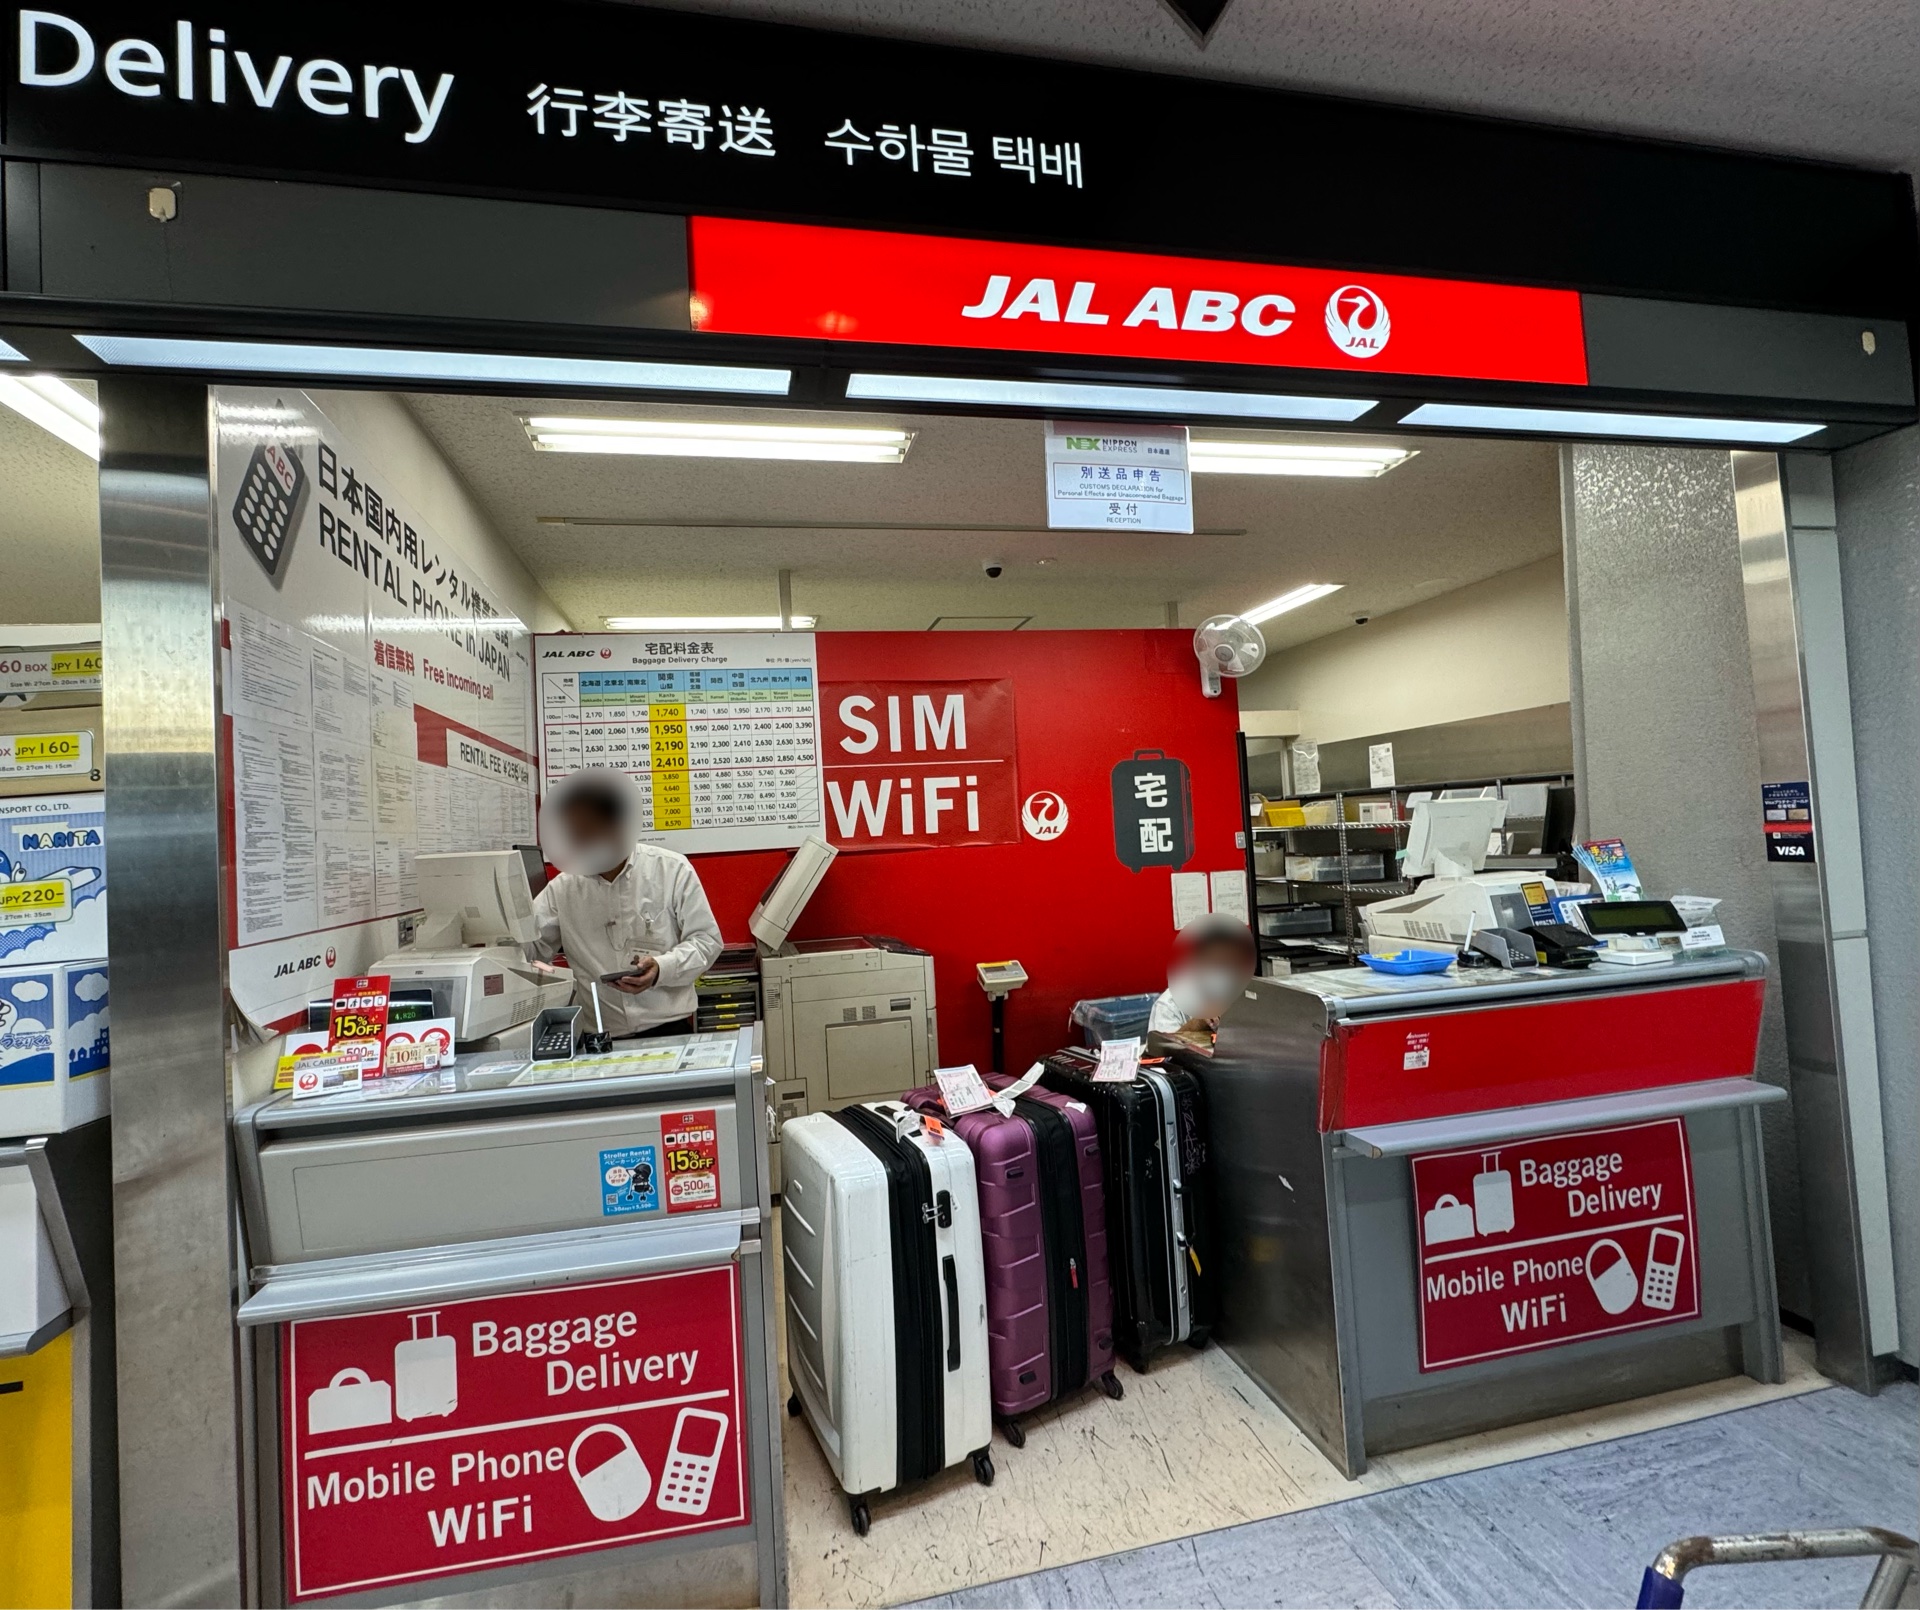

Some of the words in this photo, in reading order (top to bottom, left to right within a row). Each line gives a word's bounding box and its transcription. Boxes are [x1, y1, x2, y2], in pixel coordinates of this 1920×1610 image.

[19, 9, 454, 144] Delivery
[526, 83, 777, 158] 行李寄送
[823, 117, 974, 178] 수하물
[992, 134, 1083, 189] 택배
[961, 274, 1109, 326] JAL
[1122, 287, 1296, 337] ABC
[1345, 336, 1380, 350] JAL
[1102, 438, 1138, 447] NIPPON
[1102, 445, 1138, 454] EXPRESS
[266, 444, 295, 491] ABC
[1081, 466, 1162, 482] 別送品申告
[1079, 483, 1111, 491] CUSTOMS
[1162, 494, 1184, 502] Baggage
[1109, 503, 1138, 516] 受付
[319, 502, 408, 608] RENTAL
[412, 579, 463, 649] PHONE
[478, 636, 510, 683] JAPAN
[542, 651, 565, 659] JAL
[566, 650, 596, 658] ABC
[645, 642, 714, 656] 宅配料金表
[373, 639, 415, 676] 着信無料
[632, 657, 666, 665] Baggage
[668, 656, 699, 665] Delivery
[700, 656, 728, 664] Charge
[0, 660, 22, 674] 60
[25, 663, 48, 672] BOX
[52, 662, 71, 671] JPY
[423, 657, 445, 685] Free
[446, 667, 481, 700] incoming
[482, 683, 494, 701] call
[585, 711, 603, 719] 2,170
[656, 708, 679, 717] 1,740
[655, 724, 683, 735] 1,950
[775, 722, 793, 730] 2,400
[838, 694, 967, 754] SIM
[15, 746, 36, 756] JPY
[585, 745, 604, 753] 2,630
[655, 741, 684, 752] 2,190
[690, 741, 708, 749] 2,190
[776, 738, 794, 746] 2,630
[460, 741, 489, 770] RENTAL
[489, 753, 502, 774] FEE
[632, 760, 650, 768] 2,410
[656, 757, 685, 768] 2,410
[691, 758, 709, 766] 2,410
[713, 757, 731, 765] 2,520
[735, 756, 752, 764] 2,630
[779, 768, 795, 776] 6,290
[695, 806, 712, 814] 9,120
[717, 805, 734, 813] 9,120
[778, 802, 797, 810] 12,420
[826, 775, 980, 838] WiFi
[1134, 772, 1173, 854] 宅配
[1034, 825, 1061, 836] JAL
[22, 829, 101, 850] NARITA
[1774, 846, 1805, 856] VISA
[4, 912, 22, 920] 27cm
[274, 962, 296, 978] JAL
[297, 955, 322, 972] ABC
[335, 1016, 368, 1037] 15%
[356, 1024, 382, 1036] OFF
[313, 1058, 337, 1067] CARD
[604, 1157, 651, 1165] ベビーカーレンタル
[630, 1149, 651, 1157] Rental
[667, 1150, 700, 1171] 15%
[690, 1157, 714, 1170] OFF
[1519, 1152, 1623, 1188] Baggage
[683, 1180, 710, 1191] 500円
[1567, 1183, 1662, 1218] Delivery
[1426, 1266, 1505, 1303] Mobile
[1512, 1255, 1584, 1286] Phone
[1500, 1293, 1567, 1333] WiFi
[471, 1310, 638, 1358] Baggage
[546, 1349, 699, 1397] Delivery
[306, 1462, 436, 1510] Mobile
[451, 1446, 565, 1487] Phone
[427, 1494, 533, 1549] WiFi
